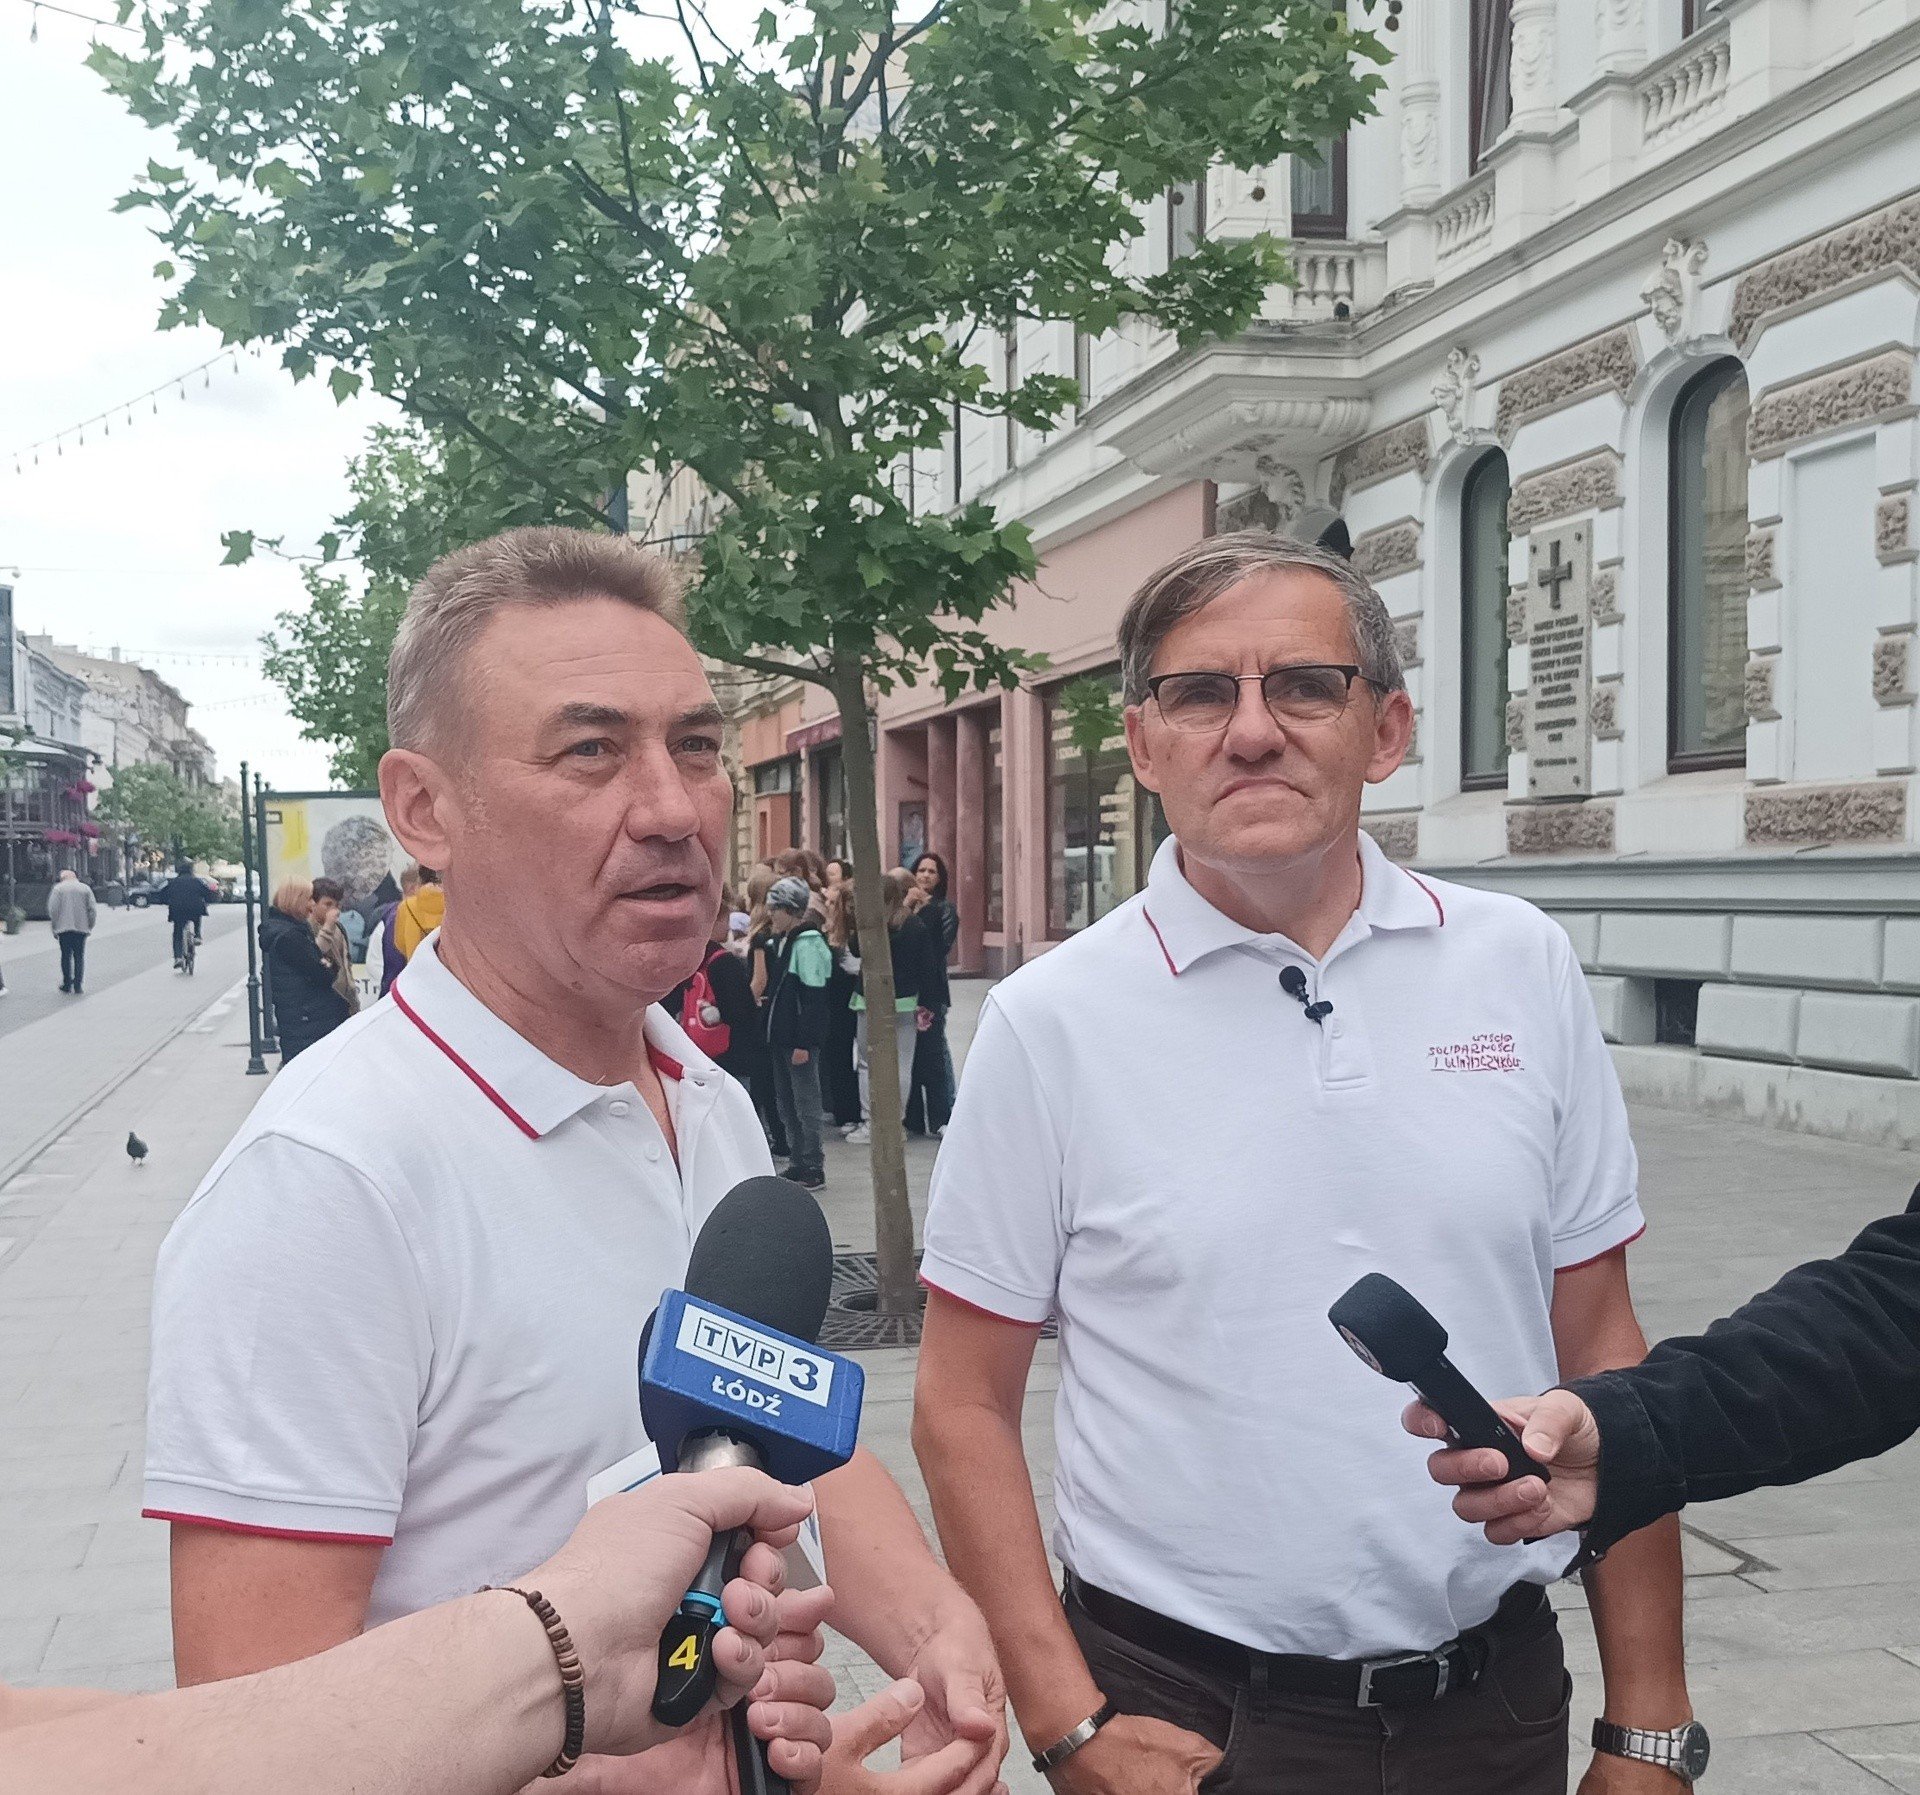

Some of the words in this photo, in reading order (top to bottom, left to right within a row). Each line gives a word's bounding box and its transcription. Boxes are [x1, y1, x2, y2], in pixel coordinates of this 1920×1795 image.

[1428, 1042, 1515, 1056] SOLIDARNOŚCI
[711, 1374, 783, 1417] ŁÓDŹ
[668, 1634, 699, 1670] 4
